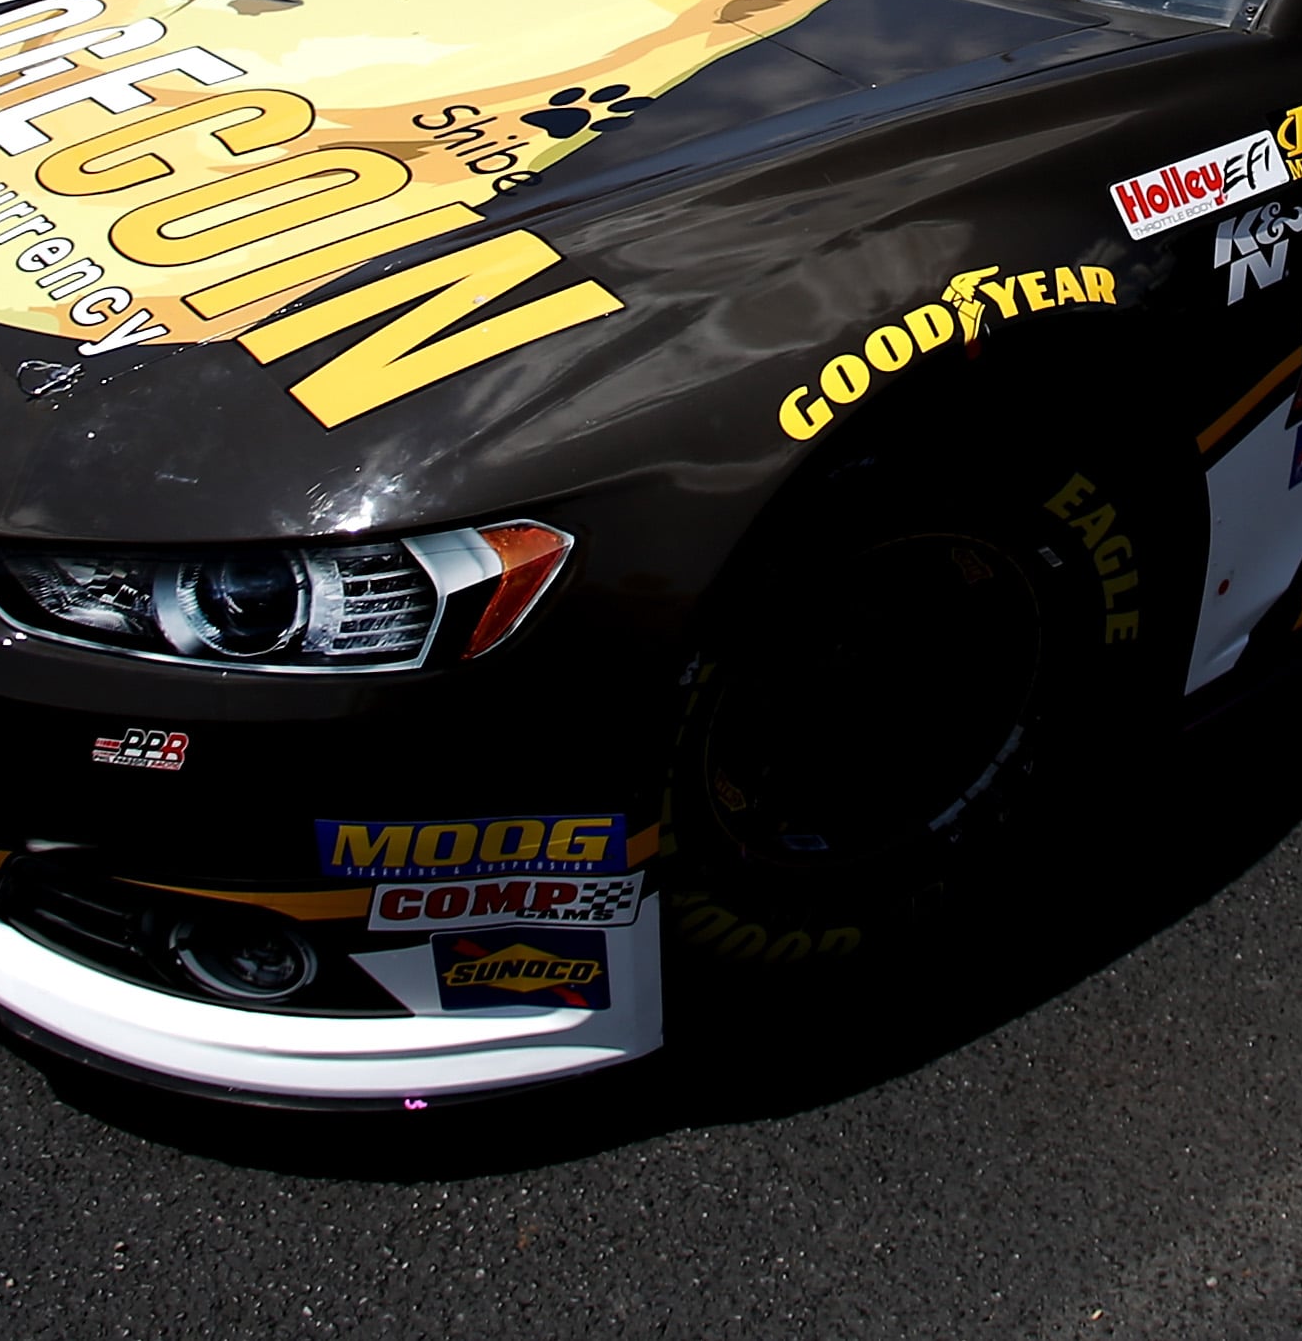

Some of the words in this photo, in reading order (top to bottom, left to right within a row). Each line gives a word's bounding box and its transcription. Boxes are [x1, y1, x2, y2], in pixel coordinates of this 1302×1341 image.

[412, 104, 543, 196] Shibe
[1116, 161, 1226, 224] Holley
[1222, 137, 1271, 194] EFI
[1133, 213, 1185, 238] THROTTLE
[1186, 200, 1214, 221] BODY
[1042, 470, 1140, 646] EAGLE
[331, 817, 613, 869] MOOG
[346, 865, 438, 878] STEERING
[476, 860, 595, 874] SUSPENSION
[379, 881, 580, 920] COMP
[515, 907, 615, 921] CAMS
[450, 960, 595, 983] SUNOCO
